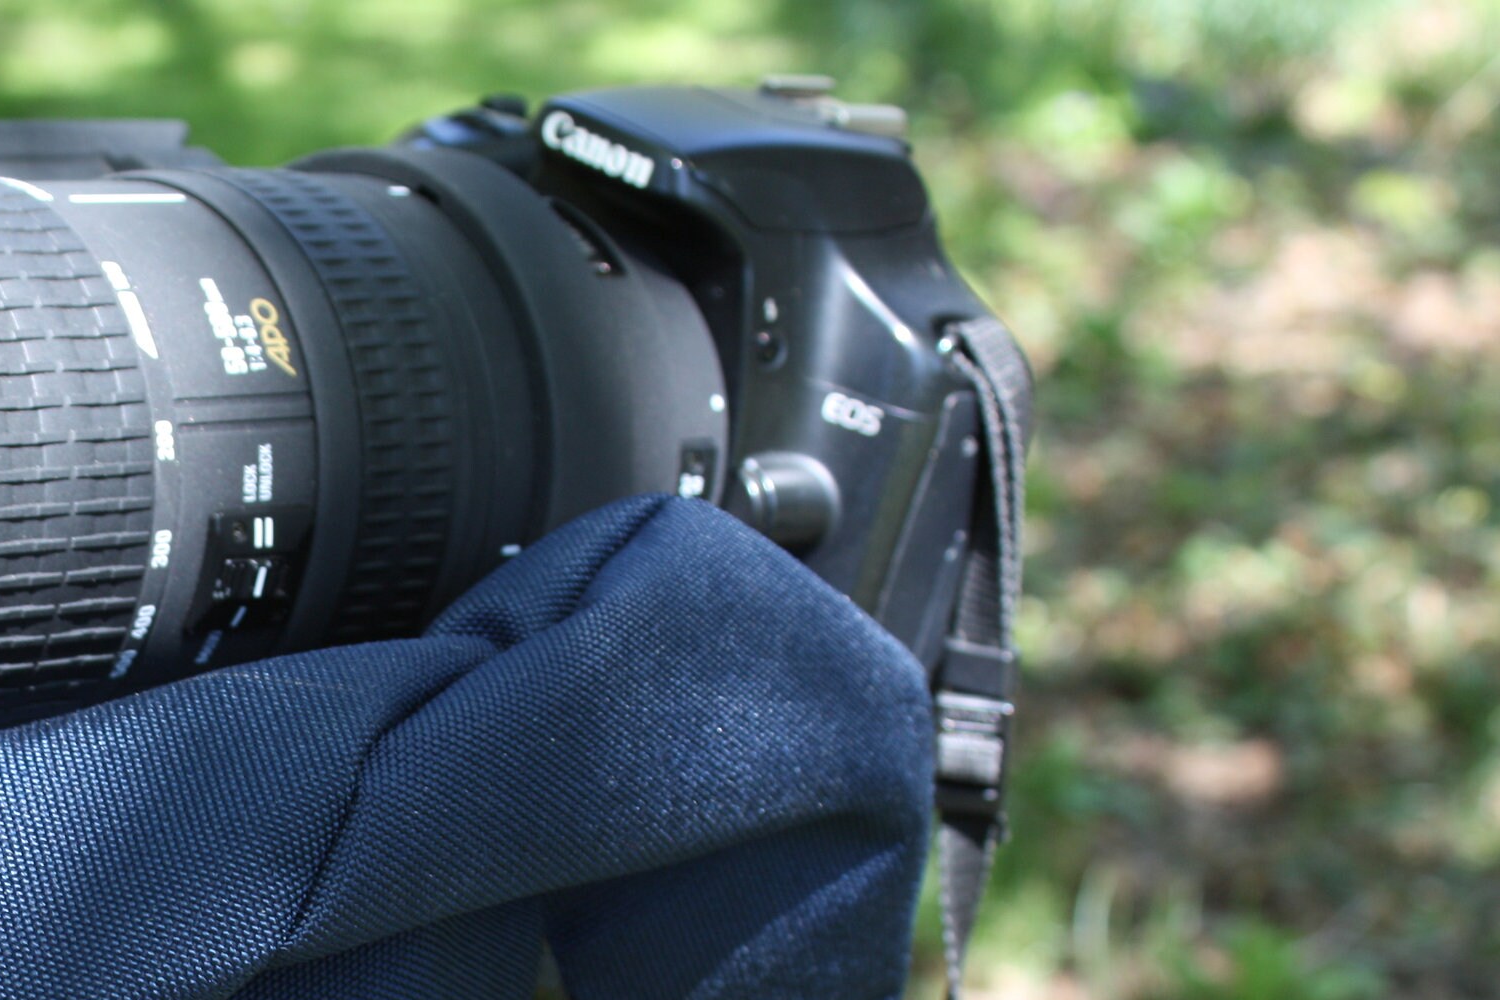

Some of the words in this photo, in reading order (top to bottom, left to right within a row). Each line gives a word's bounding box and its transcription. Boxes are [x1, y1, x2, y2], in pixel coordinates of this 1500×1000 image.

[542, 110, 655, 188] Canon
[250, 297, 298, 378] APO
[821, 391, 884, 436] EOS
[155, 419, 176, 461] 200
[243, 464, 258, 503] LOCK
[258, 442, 274, 502] UNLOCK
[150, 528, 173, 569] 300
[130, 603, 157, 641] 400
